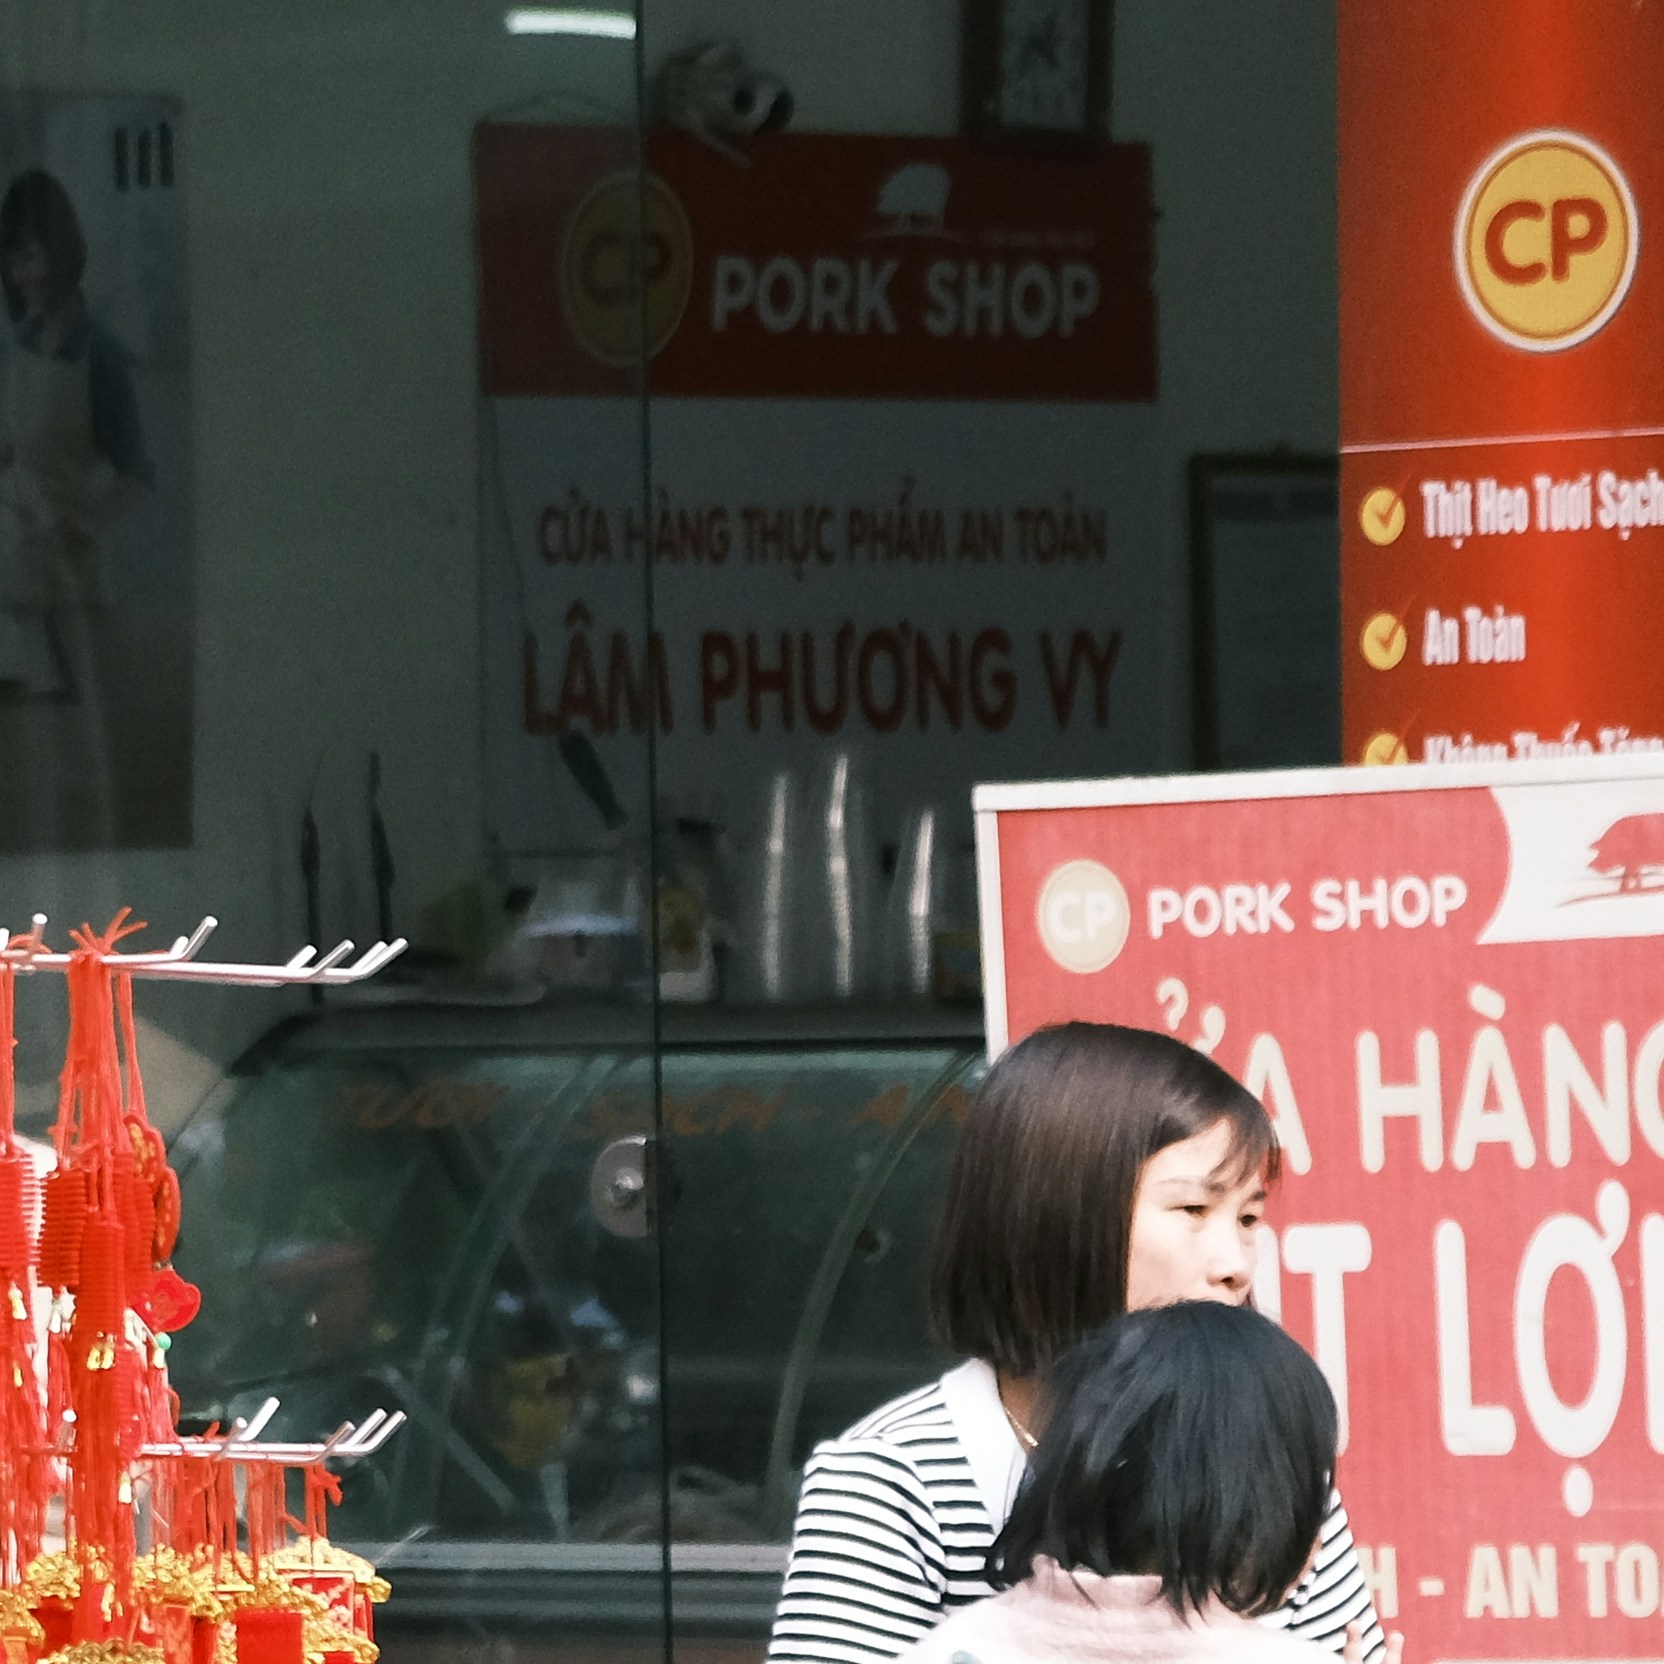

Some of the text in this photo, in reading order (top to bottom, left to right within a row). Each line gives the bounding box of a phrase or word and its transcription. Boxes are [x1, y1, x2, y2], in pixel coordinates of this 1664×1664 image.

[1484, 196, 1608, 286] CP
[709, 253, 1101, 338] PORK SHOP
[956, 505, 1005, 563] AN
[1421, 480, 1472, 550] Thịt
[1476, 477, 1529, 535] Heo
[1598, 469, 1664, 541] Sạch
[521, 600, 1123, 738] LÂM PHƯƠNG VY
[1424, 604, 1527, 666] An Toàn
[1048, 888, 1118, 942] CP
[1147, 874, 1469, 941] PORK SHOP
[1432, 1178, 1664, 1520] LỢ
[1466, 1544, 1559, 1619] AN
[1578, 1545, 1664, 1619] TO
